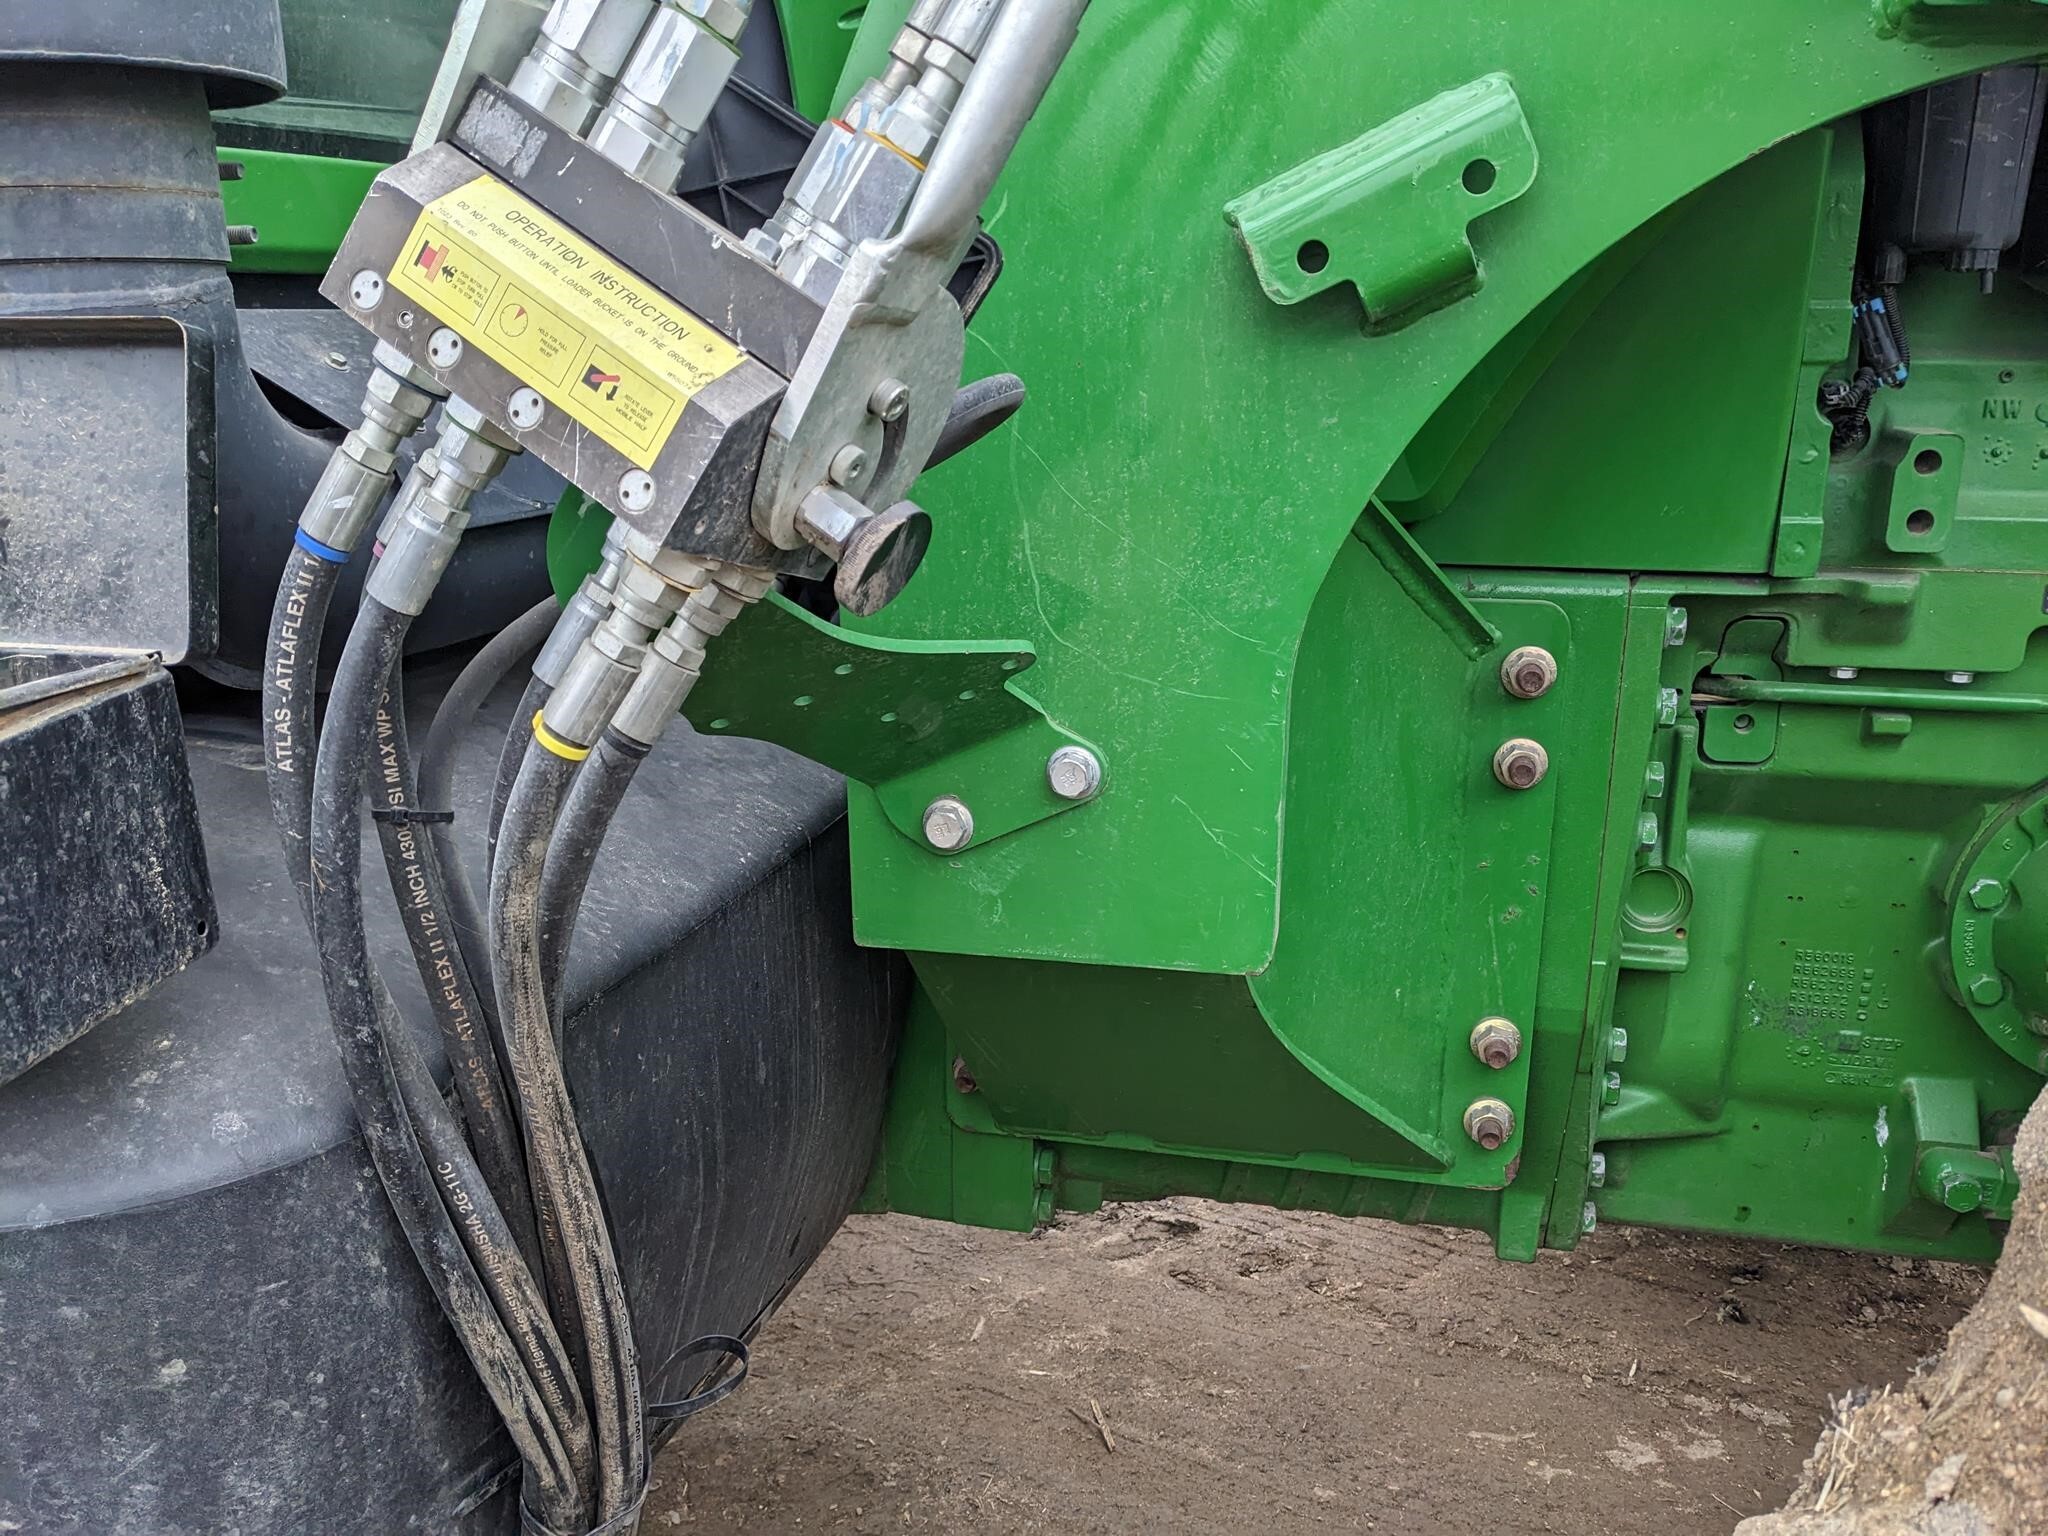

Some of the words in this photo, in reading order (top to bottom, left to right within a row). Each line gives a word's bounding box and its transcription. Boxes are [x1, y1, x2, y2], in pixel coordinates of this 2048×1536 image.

[457, 200, 470, 211] DO
[470, 210, 488, 223] NOT
[487, 222, 509, 238] PUSH
[508, 238, 539, 260] BUTTON
[539, 259, 560, 277] UNTIL
[561, 275, 592, 298] LOADER
[593, 297, 623, 320] BUCKET
[634, 327, 648, 338] ON
[649, 337, 667, 351] THE
[505, 210, 590, 269] OPERATION
[590, 270, 691, 341] INSTRUCTION
[1982, 399, 2022, 419] NW
[275, 592, 309, 697] ATLAFLEX
[274, 708, 294, 773] ATLAS
[377, 710, 393, 739] WP
[380, 741, 402, 786] MAX
[404, 864, 429, 910] INCH
[421, 912, 440, 937] 1/2
[436, 959, 477, 1042] ATLAFLEX
[437, 1161, 476, 1214] 2G-11C
